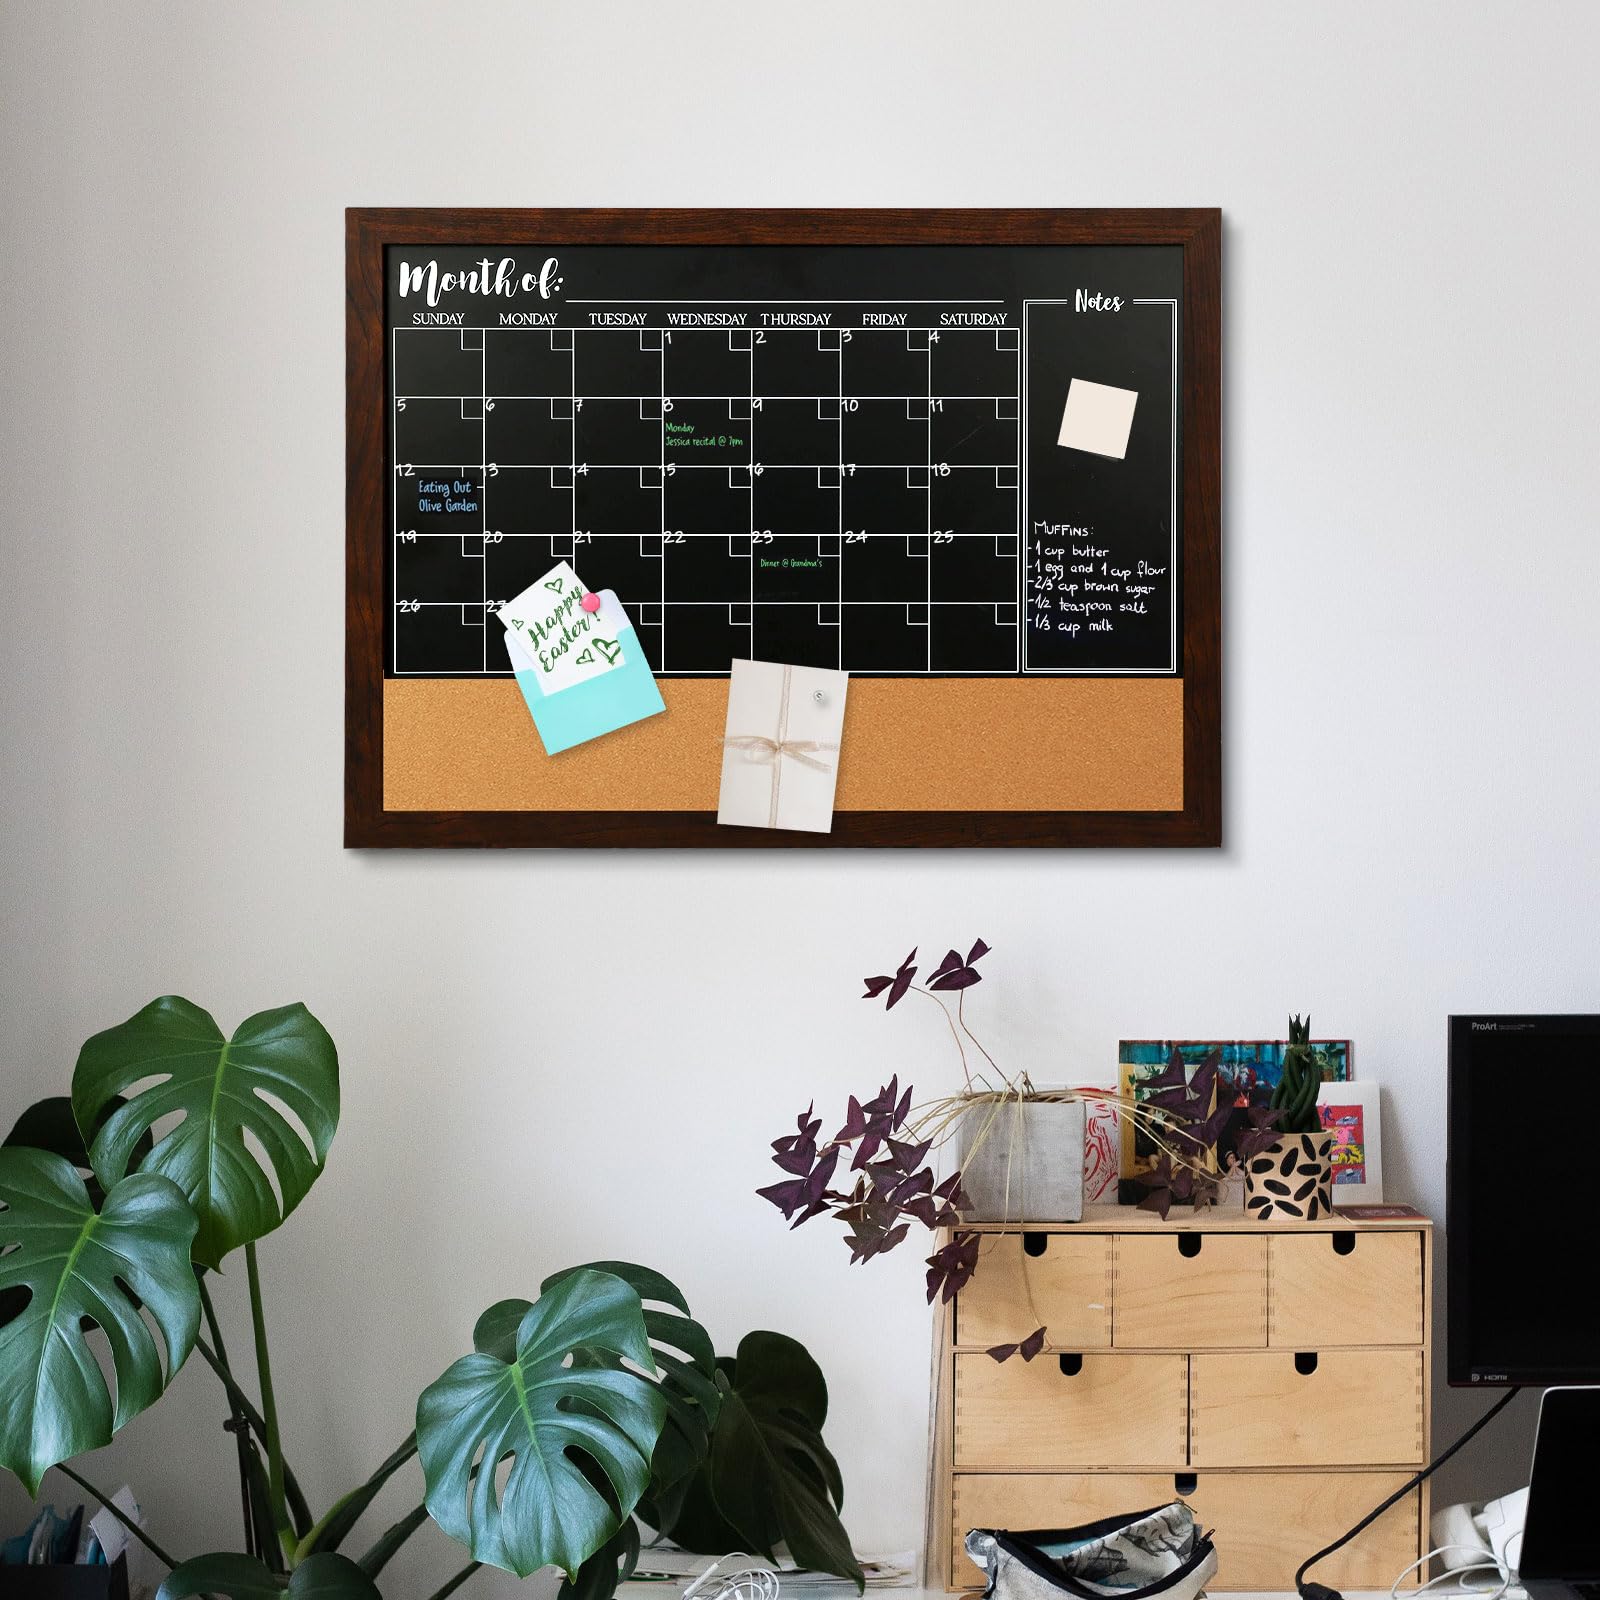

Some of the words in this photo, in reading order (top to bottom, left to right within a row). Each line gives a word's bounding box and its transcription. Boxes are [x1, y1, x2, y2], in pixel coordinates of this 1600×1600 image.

[399, 257, 519, 308] Month
[521, 257, 564, 300] of:
[1075, 288, 1125, 313] Notes
[412, 312, 465, 325] SUNDAY
[499, 312, 558, 325] MONDAY
[588, 312, 648, 326] TUESDAY
[666, 312, 748, 326] WEDNESDAY
[760, 313, 832, 326] THURSDAY
[862, 313, 908, 326] FRIDAY
[940, 313, 1008, 326] SATURDAY
[664, 331, 672, 345] 1
[755, 330, 767, 344] 2
[842, 329, 853, 343] 3
[928, 329, 941, 344] 4
[397, 399, 407, 412] 5
[485, 398, 495, 412] 6
[573, 399, 584, 412] 7
[663, 399, 674, 412] 8
[752, 399, 763, 412] 9
[841, 399, 859, 413] 10
[929, 399, 943, 413] 11
[665, 422, 695, 434] Monday
[665, 436, 691, 446] Jessica
[692, 436, 716, 446] recital
[728, 435, 744, 448] 7pm
[395, 463, 416, 477] 12
[480, 462, 499, 477] 13
[568, 462, 590, 477] 14
[658, 462, 676, 477] 15
[746, 462, 764, 477] 16
[839, 463, 857, 477] 17
[931, 462, 951, 477] 18
[418, 480, 450, 498] Eating
[453, 480, 472, 494] Out
[418, 498, 443, 512] Olive
[445, 498, 479, 513] Garden
[400, 529, 417, 544] 19
[483, 530, 503, 544] 20
[573, 530, 592, 544] 21
[663, 530, 687, 544] 22
[751, 529, 774, 545] 23
[845, 529, 868, 544] 24
[933, 529, 954, 544] 25
[1044, 546, 1066, 561] cup
[1072, 544, 1110, 558] butter
[760, 558, 780, 568] Dinner
[790, 558, 823, 568] Grandma's
[1045, 563, 1065, 581] egg
[1070, 562, 1094, 574] and
[1100, 561, 1107, 576] 1
[1110, 567, 1132, 581] cup
[1136, 559, 1167, 578] flour
[1058, 582, 1079, 597] cup
[1084, 578, 1119, 592] brown
[1125, 586, 1156, 599] sugar
[400, 600, 421, 613] 26
[1059, 596, 1112, 617] teaspoon
[1119, 601, 1148, 614] salt
[528, 586, 583, 651] Happy
[1057, 622, 1081, 639] cup
[1089, 617, 1114, 631] milk
[1471, 1022, 1498, 1031] ProArt
